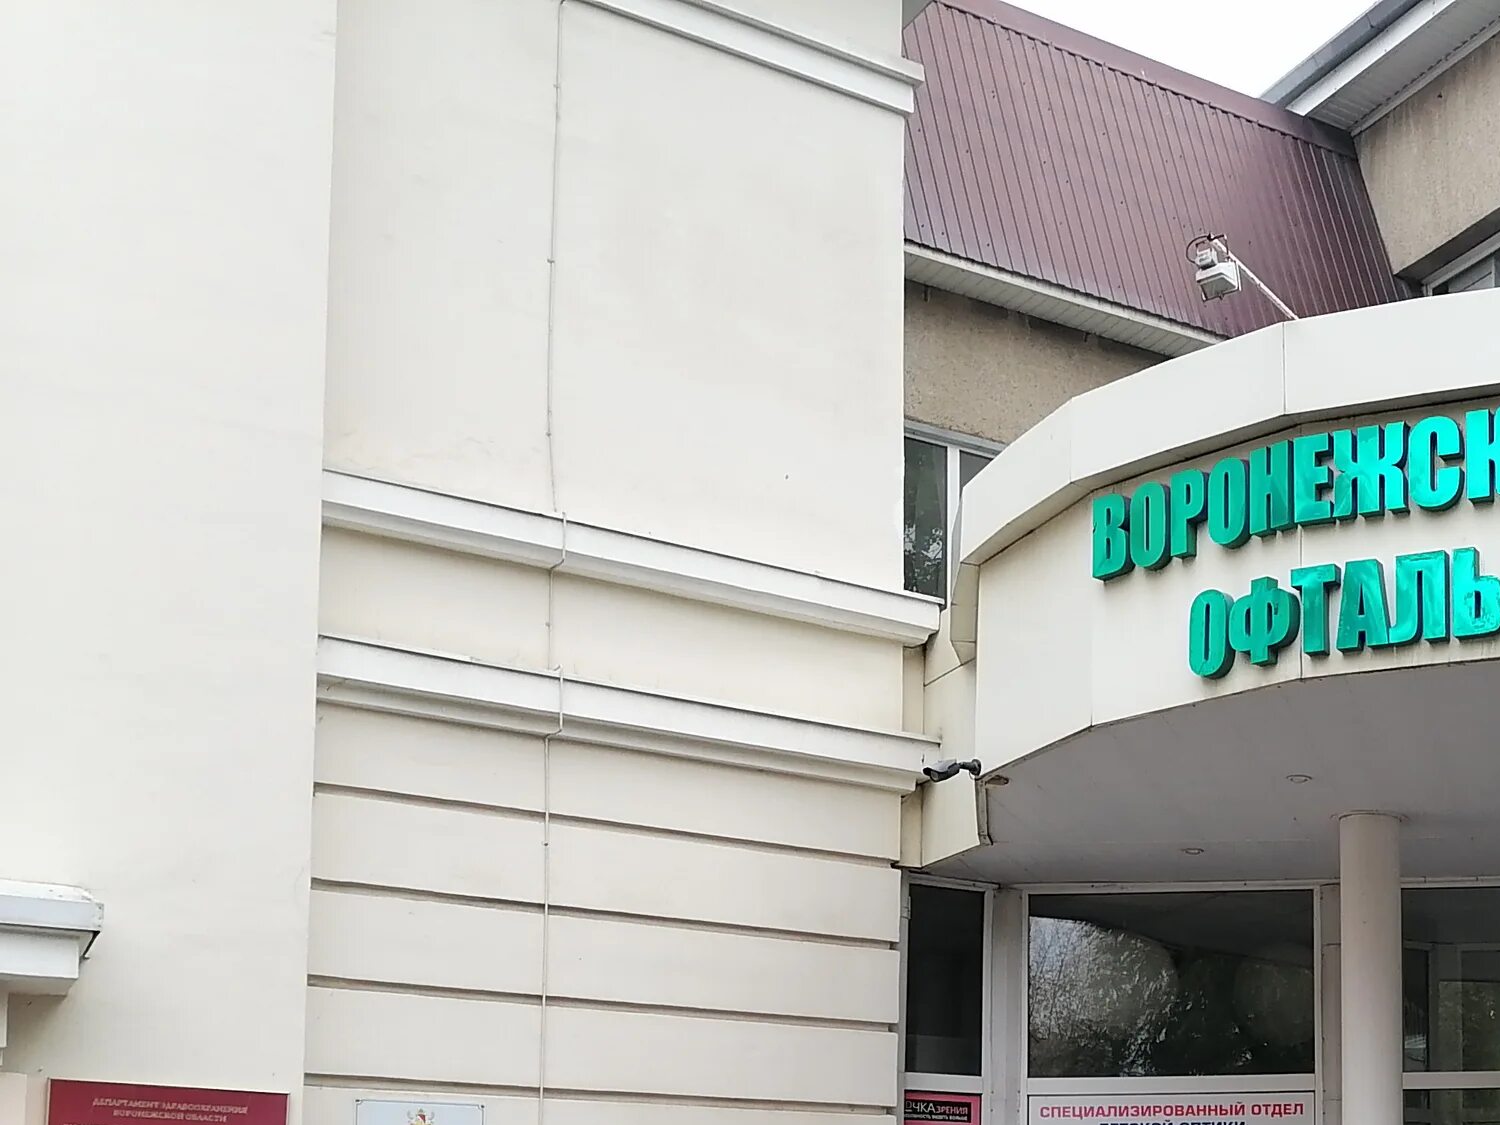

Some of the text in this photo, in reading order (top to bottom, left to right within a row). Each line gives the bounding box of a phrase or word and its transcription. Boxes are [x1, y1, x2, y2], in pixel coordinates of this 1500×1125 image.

[904, 1101, 935, 1113] ОЧКА
[1040, 1102, 1304, 1119] СПЕЦИАЛИЗИРОВАННЫЙ ОТДЕЛ
